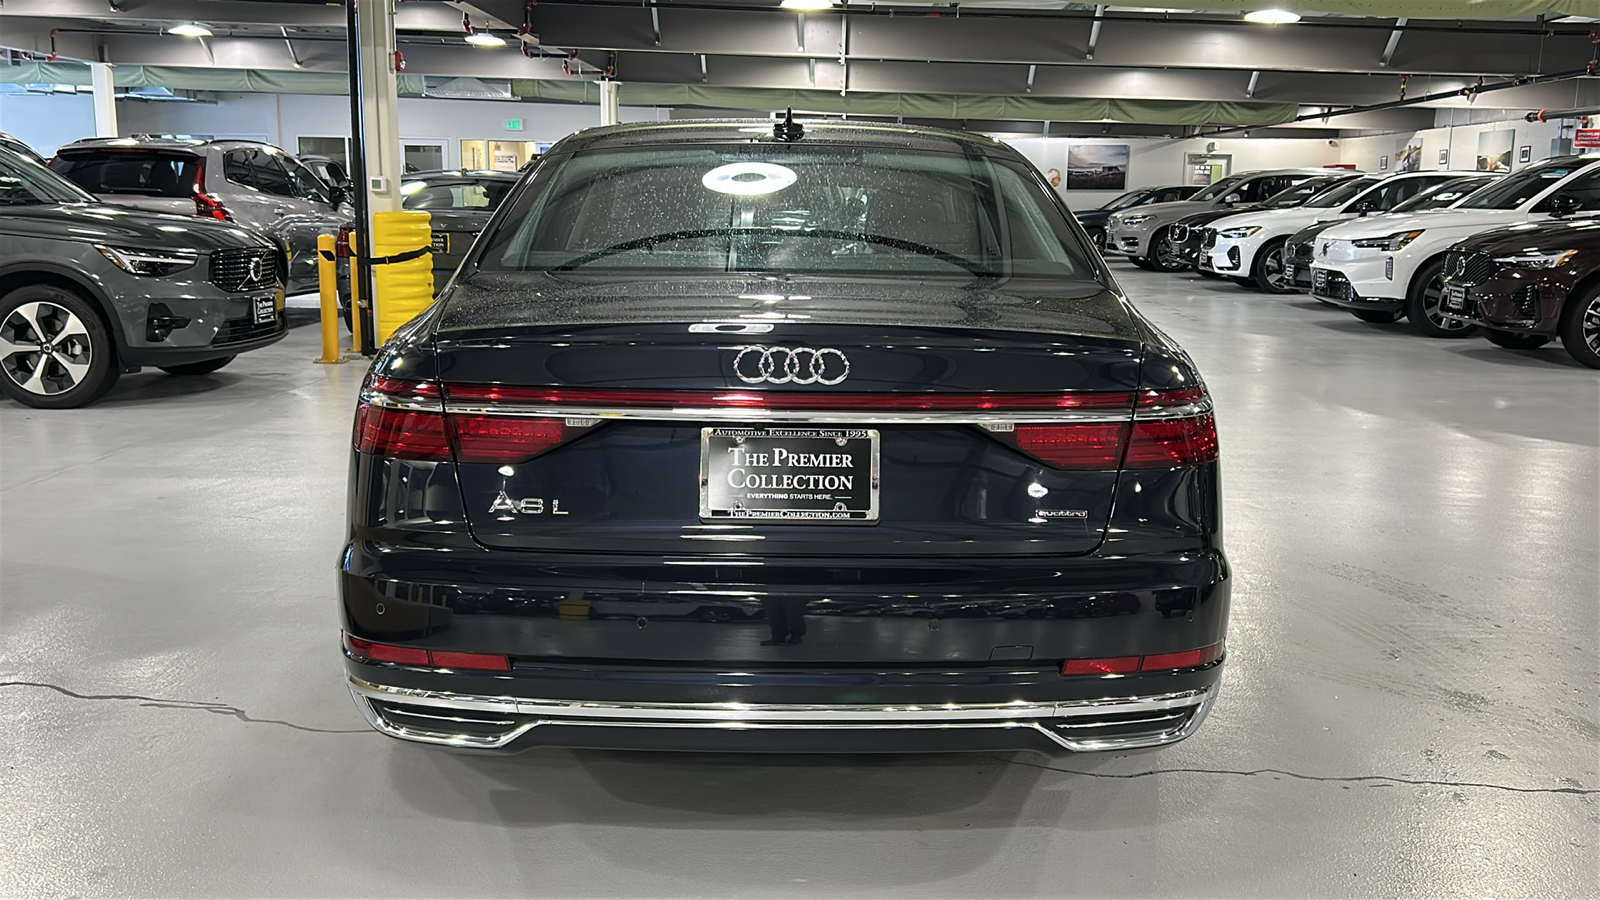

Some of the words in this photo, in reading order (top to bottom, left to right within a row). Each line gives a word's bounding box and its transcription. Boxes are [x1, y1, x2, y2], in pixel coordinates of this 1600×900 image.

[714, 429, 767, 437] AUTOMOTIVE
[768, 429, 818, 437] EXCELLENCE
[845, 430, 867, 438] 1995
[728, 447, 769, 467] THE
[772, 447, 854, 468] PREMIER
[727, 468, 854, 490] COLLECTION
[488, 491, 544, 514] A8
[552, 499, 569, 515] L
